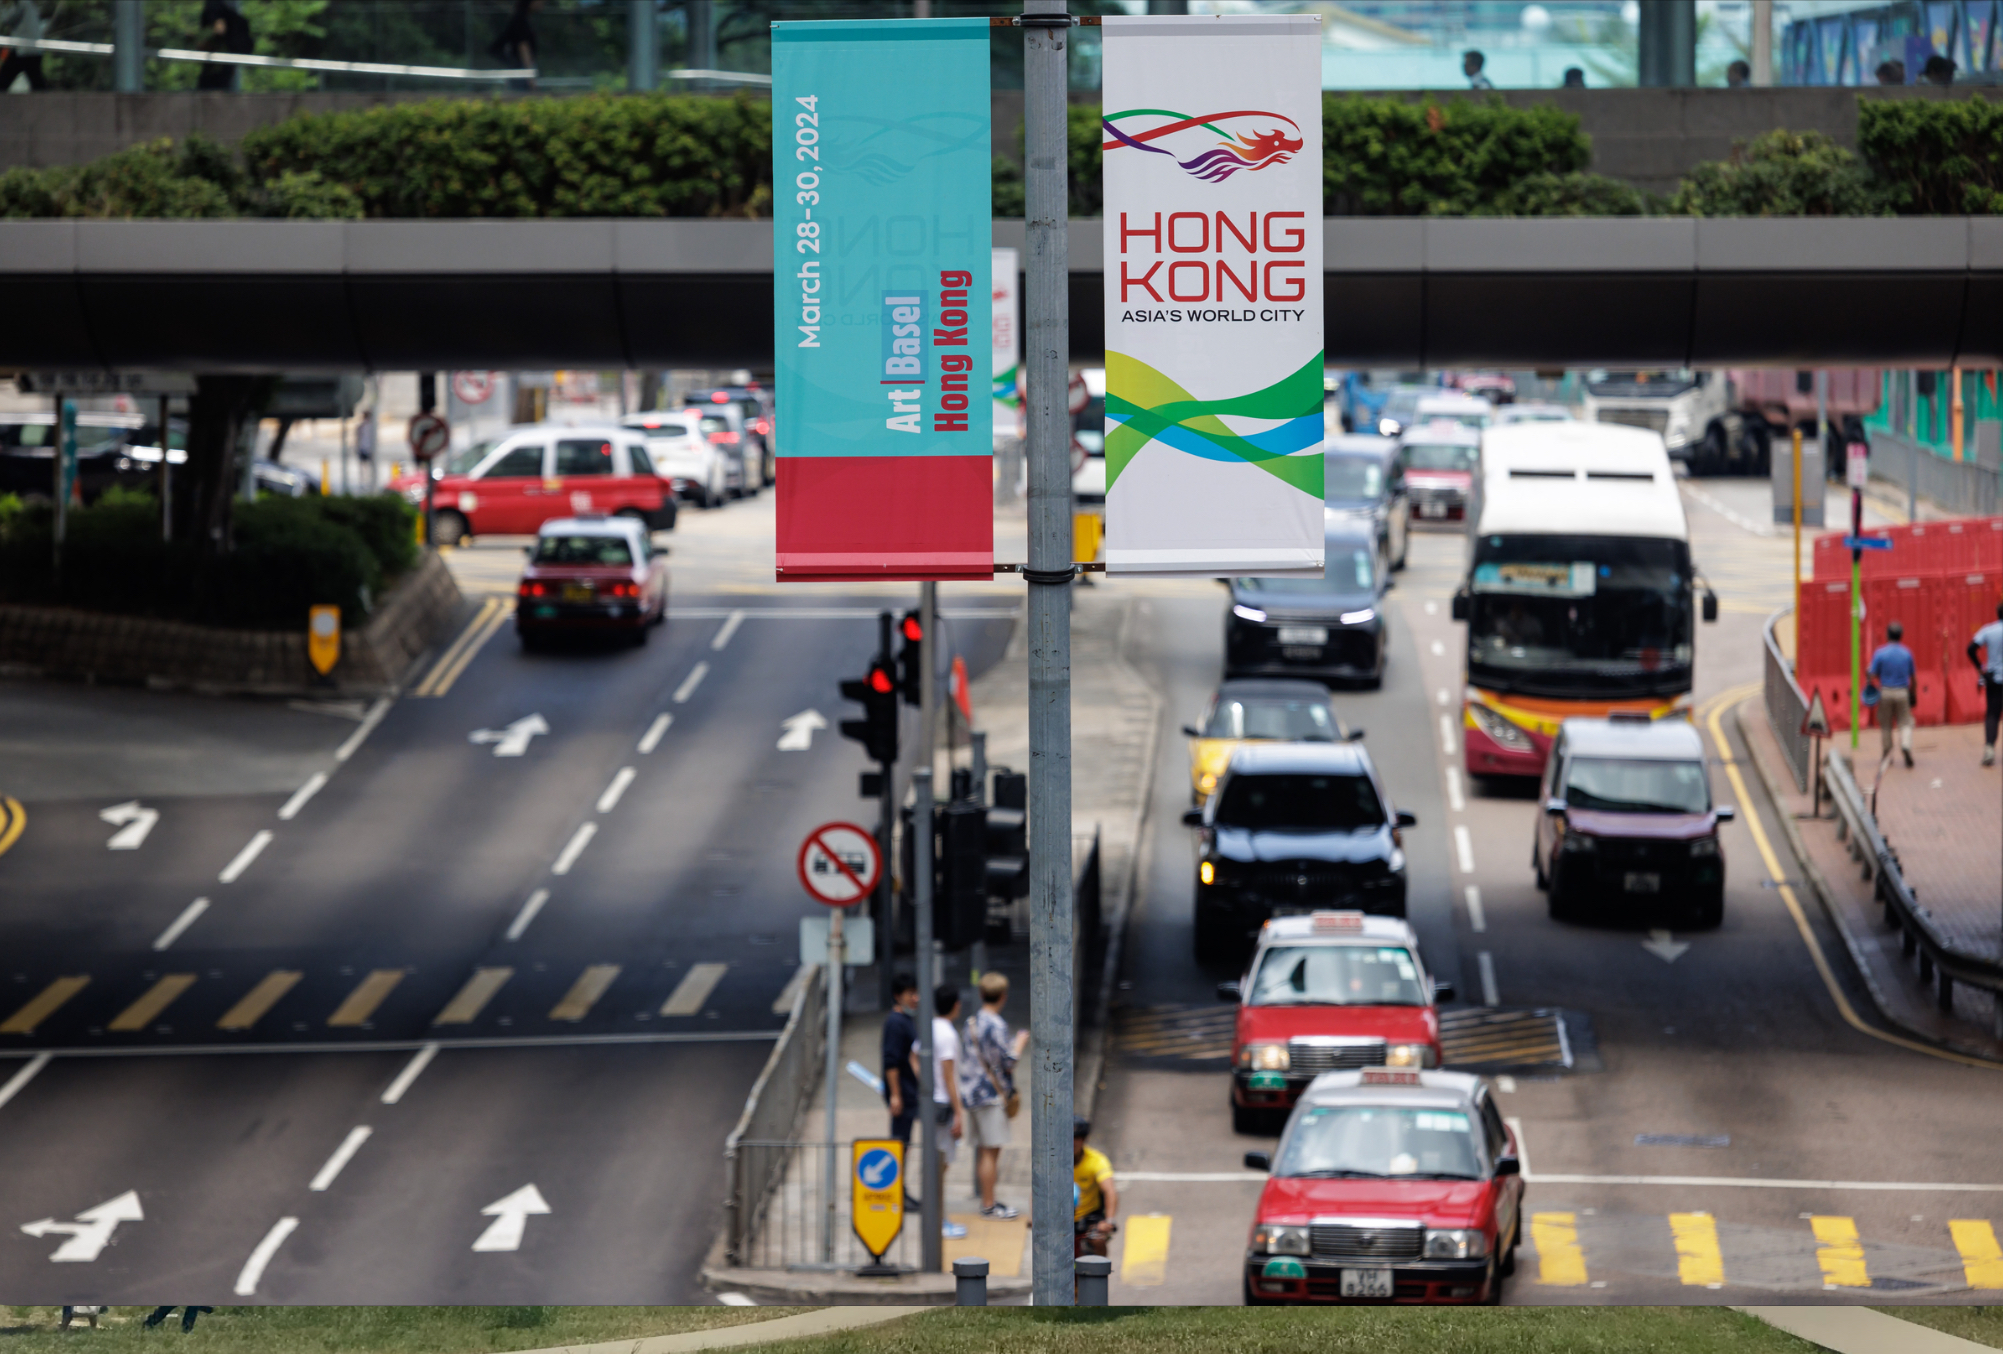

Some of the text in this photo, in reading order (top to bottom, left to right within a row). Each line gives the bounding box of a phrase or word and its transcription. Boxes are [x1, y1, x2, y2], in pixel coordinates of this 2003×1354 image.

[795, 94, 820, 161] 2024
[1120, 211, 1306, 254] HONG
[797, 262, 821, 348] March
[1120, 260, 1306, 303] KONG
[1121, 309, 1305, 323] ASIA'S WORLD CITY
[885, 296, 921, 434] Art Basel
[933, 270, 973, 432] Hong Kong
